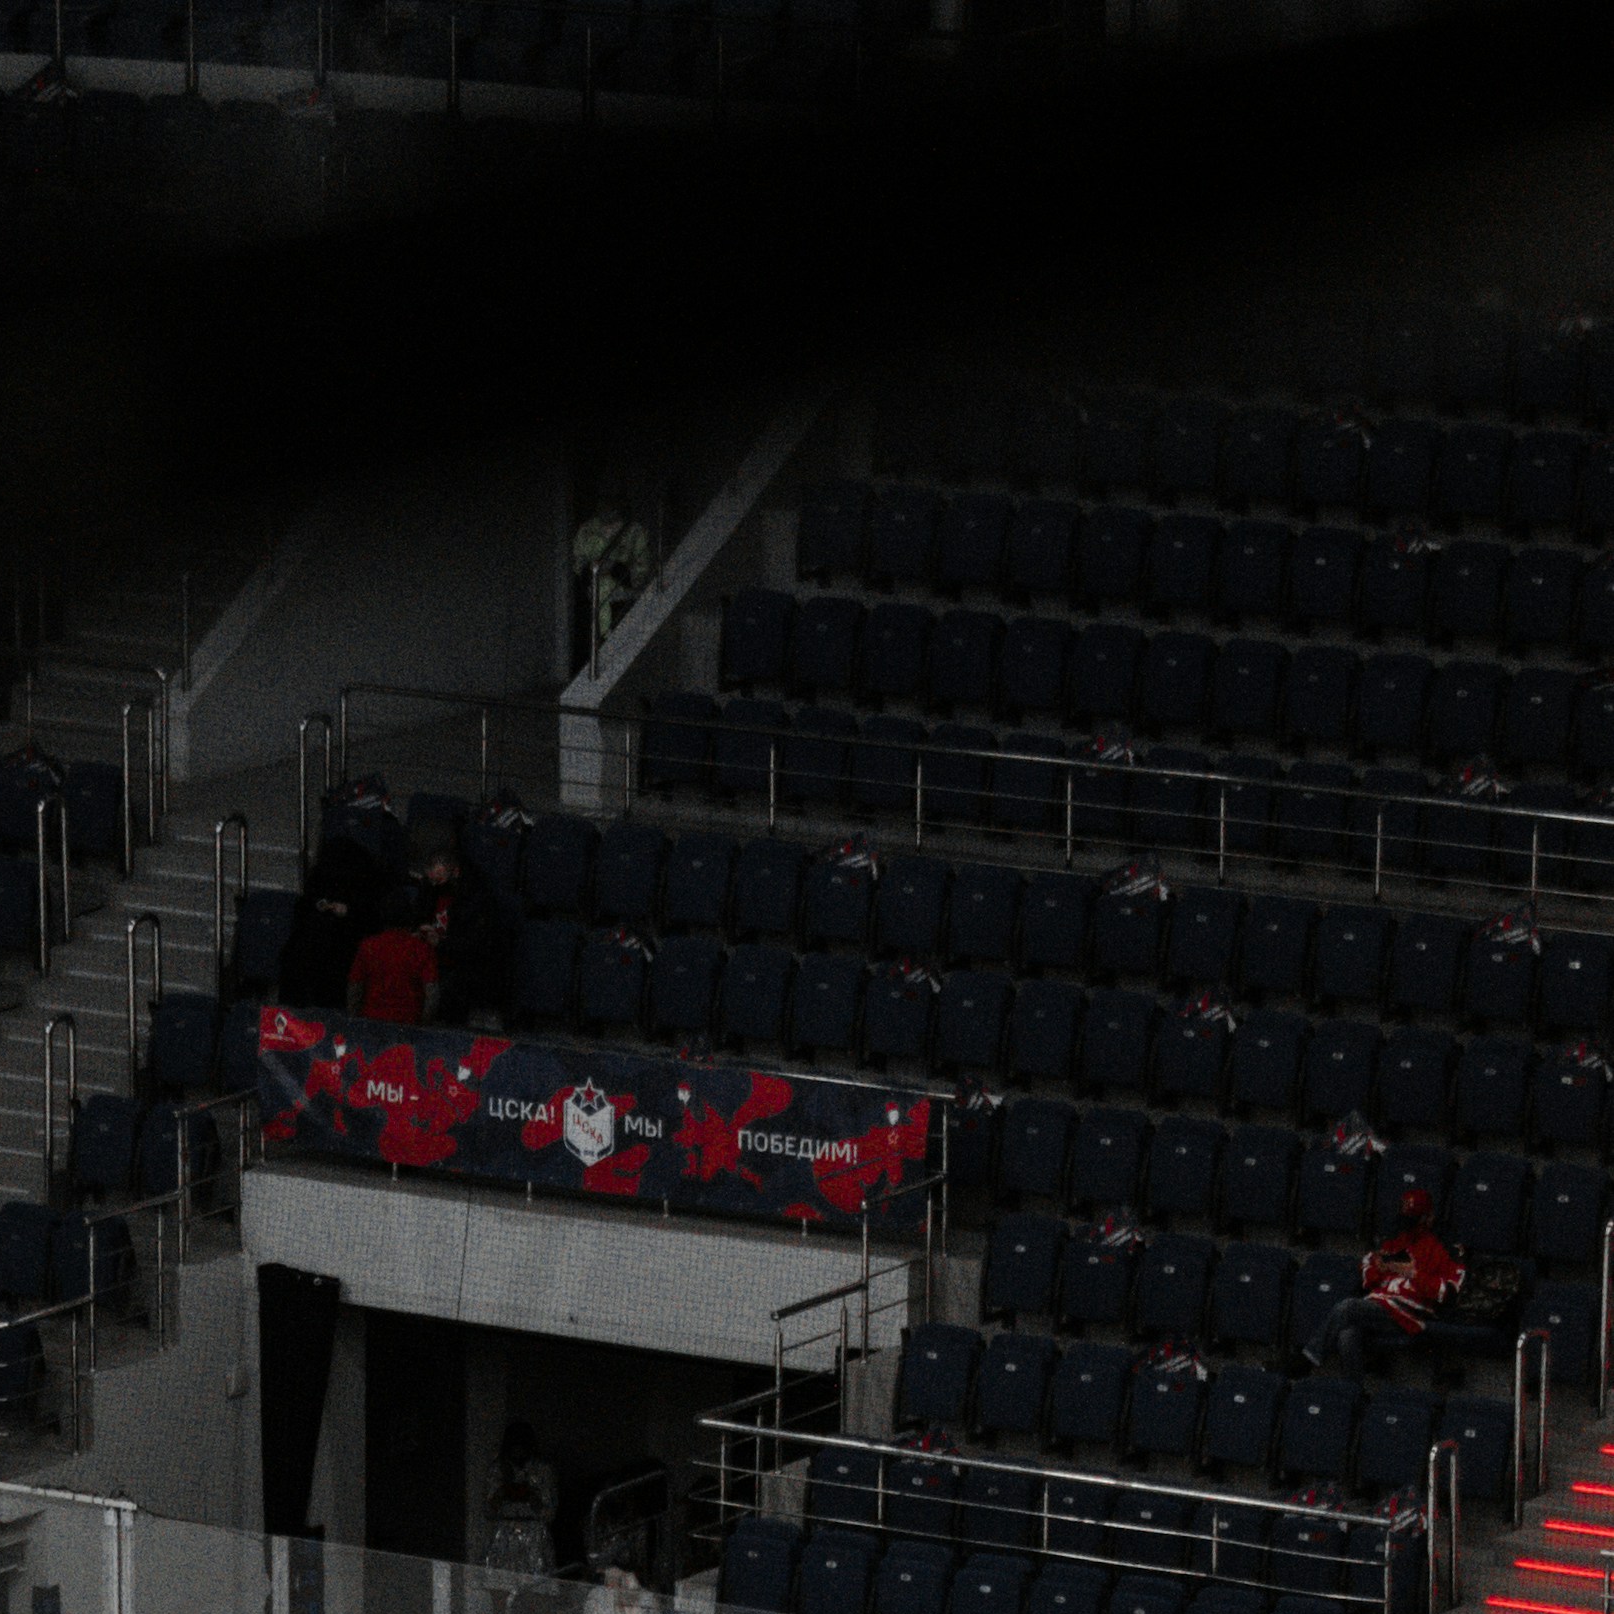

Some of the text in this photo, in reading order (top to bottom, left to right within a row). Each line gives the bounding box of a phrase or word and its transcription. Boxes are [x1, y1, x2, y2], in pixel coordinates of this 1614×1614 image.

[366, 1079, 404, 1105] МЫ
[488, 1096, 556, 1125] ЦСКА!
[624, 1114, 663, 1139] МЫ
[737, 1128, 858, 1165] ПОБЕДИМ!
